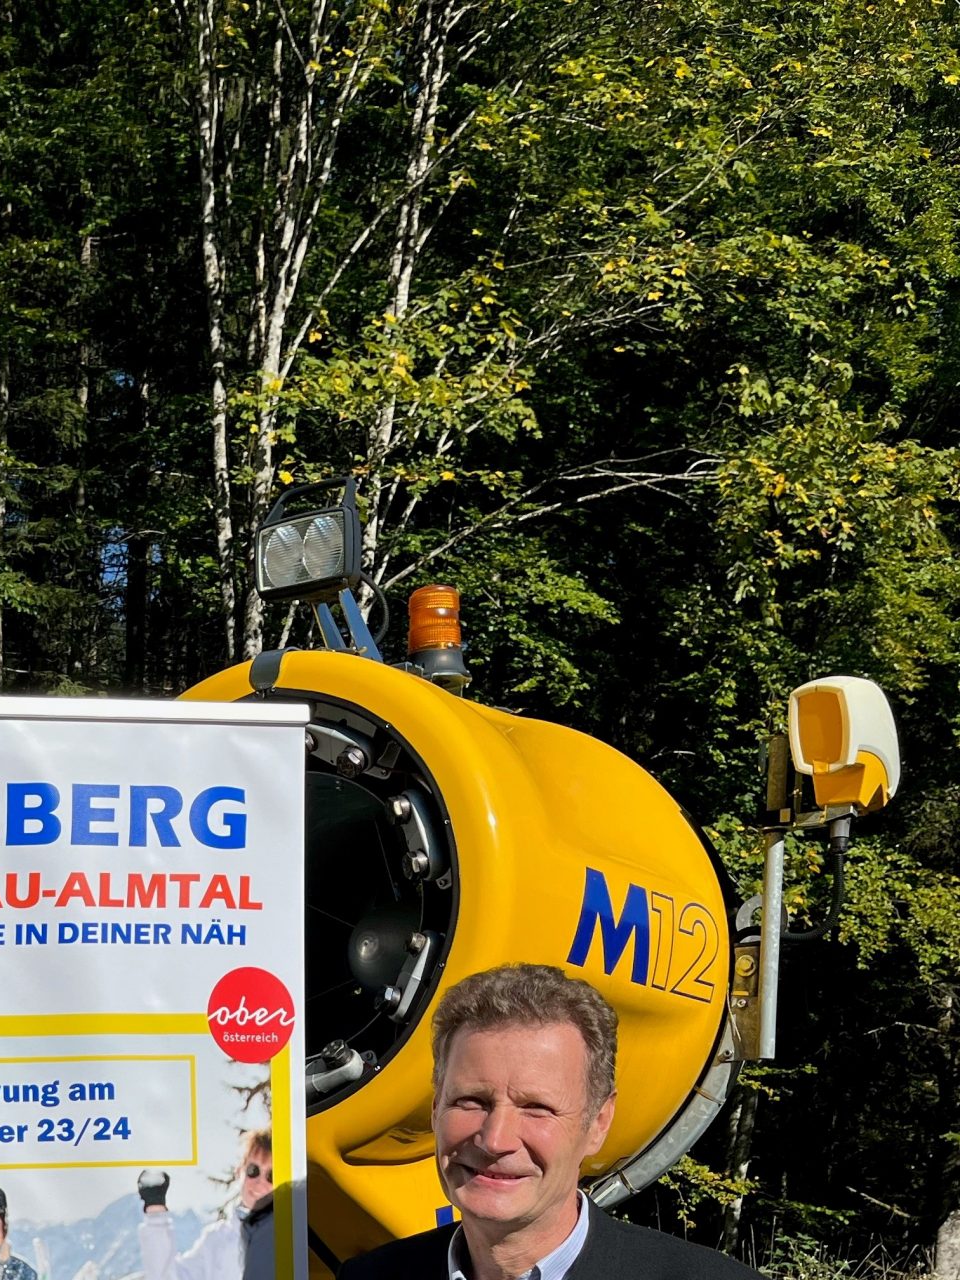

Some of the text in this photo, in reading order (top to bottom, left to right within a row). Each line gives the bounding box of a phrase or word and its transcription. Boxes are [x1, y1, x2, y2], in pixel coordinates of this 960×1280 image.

[15, 923, 48, 945] IN
[58, 922, 172, 945] DEINER
[181, 918, 246, 945] NÄH
[567, 866, 718, 1004] M12
[208, 995, 295, 1026] ober
[222, 1031, 279, 1043] österreich
[68, 1082, 115, 1102] am
[37, 1117, 131, 1143] 23/24
